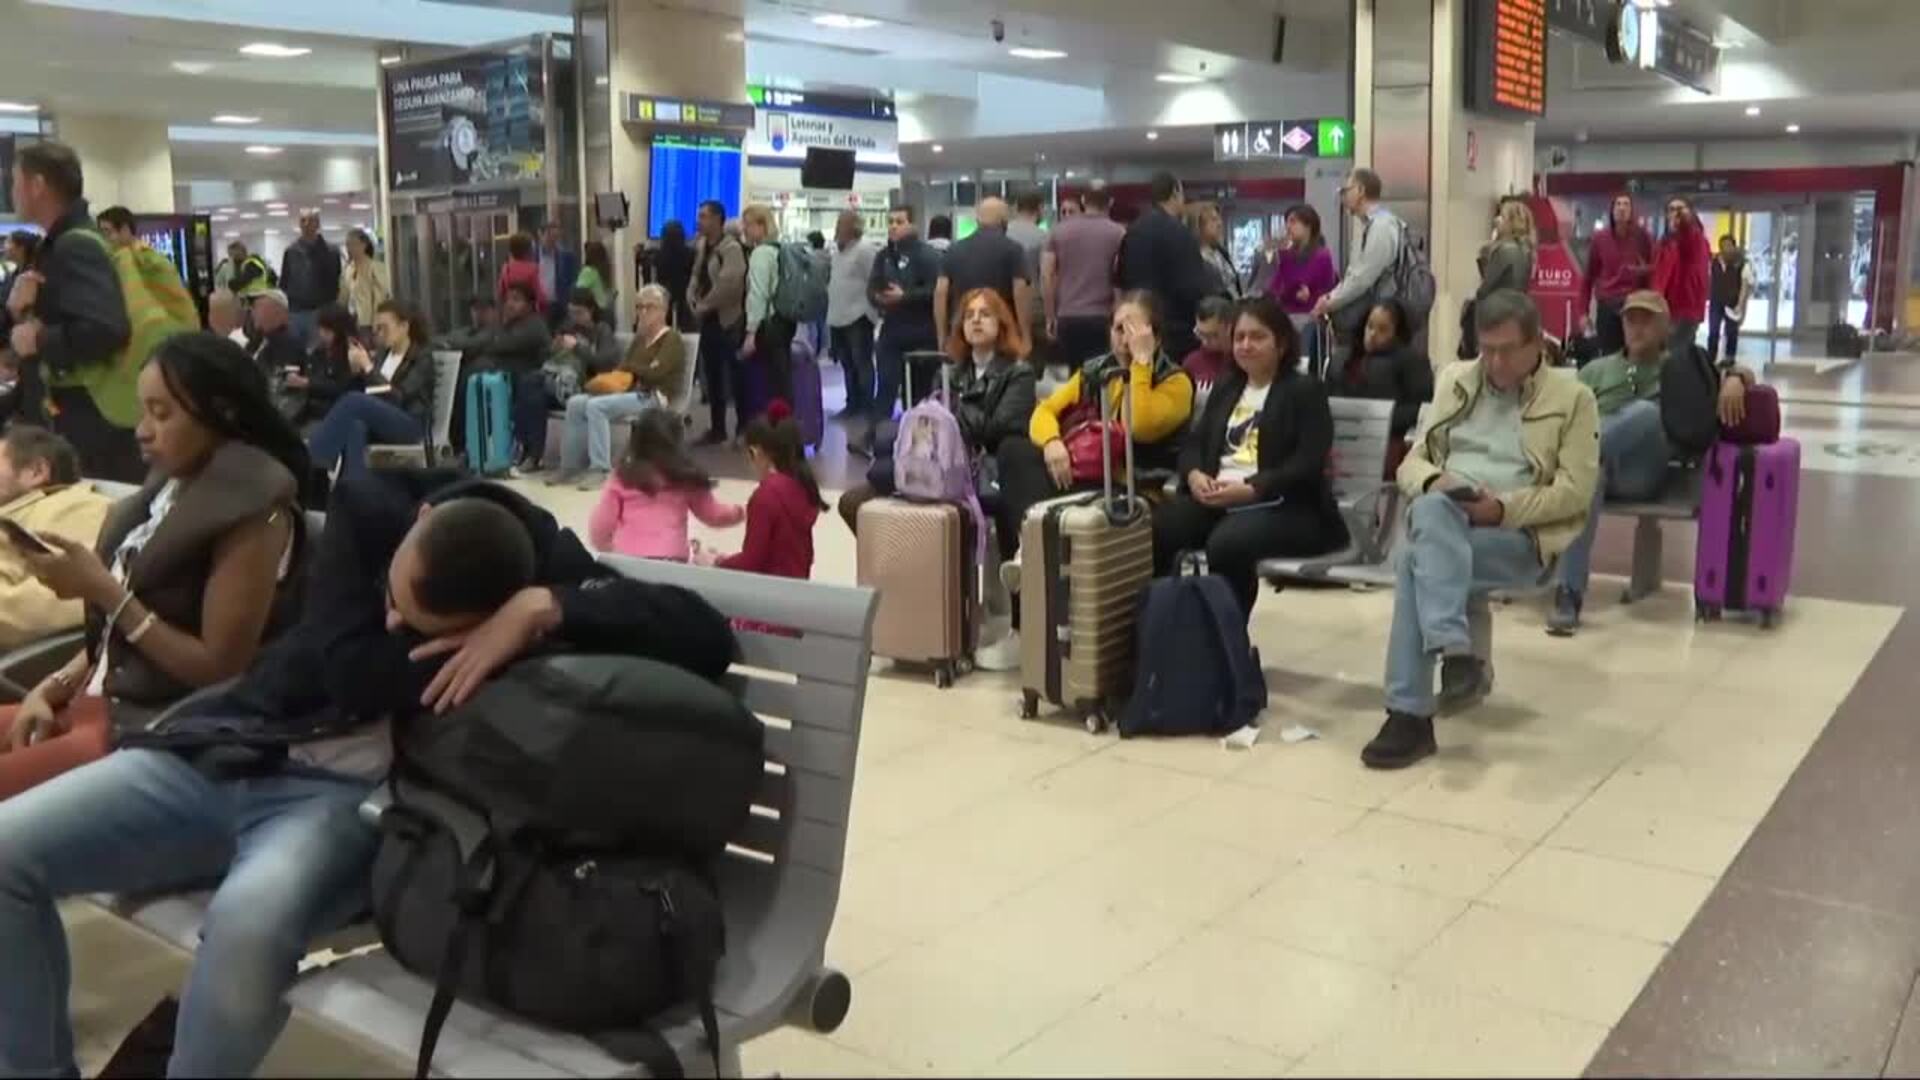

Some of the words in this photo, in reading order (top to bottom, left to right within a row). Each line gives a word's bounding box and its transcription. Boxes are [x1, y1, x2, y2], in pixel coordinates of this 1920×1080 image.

[411, 75, 438, 89] PAUSA
[440, 71, 462, 84] PARA
[791, 131, 831, 145] Apuestas
[833, 134, 846, 145] del
[848, 136, 876, 148] Estado
[1538, 269, 1572, 279] EURO
